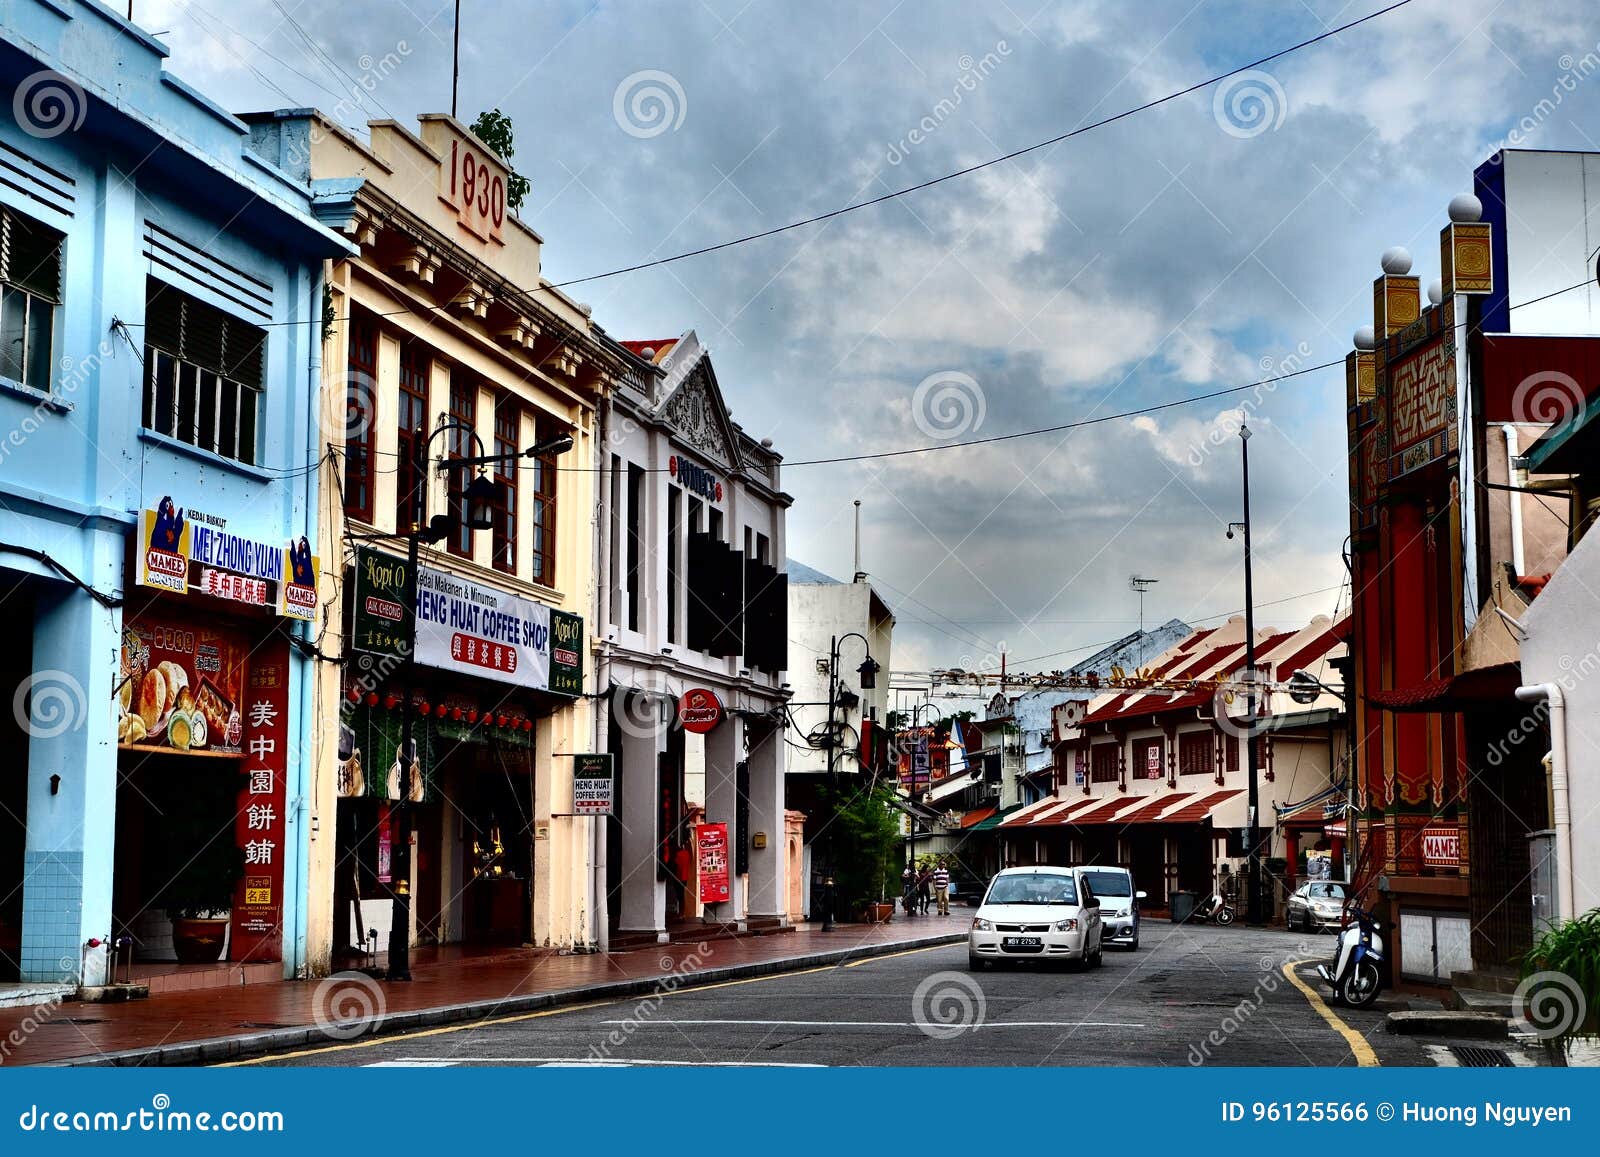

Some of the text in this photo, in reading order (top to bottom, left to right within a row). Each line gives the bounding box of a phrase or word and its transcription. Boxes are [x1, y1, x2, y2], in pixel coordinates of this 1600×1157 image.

[451, 139, 503, 229] 1930
[187, 508, 204, 521] KEDAI
[150, 553, 184, 573] MAMEE
[192, 525, 281, 580] MEI ZHONG YUAN
[367, 557, 404, 589] Kopi O
[289, 585, 316, 605] MAMEE
[434, 575, 463, 600] Makanan
[464, 586, 469, 601] &
[470, 586, 498, 608] Minuman
[379, 602, 401, 619] CHEONG
[415, 588, 548, 652] HENG HUAT COFFEE SHOP
[245, 700, 278, 865] 美中園餅鋪
[575, 780, 610, 790] HENG HUAT
[575, 791, 610, 799] COFFEE SHOP
